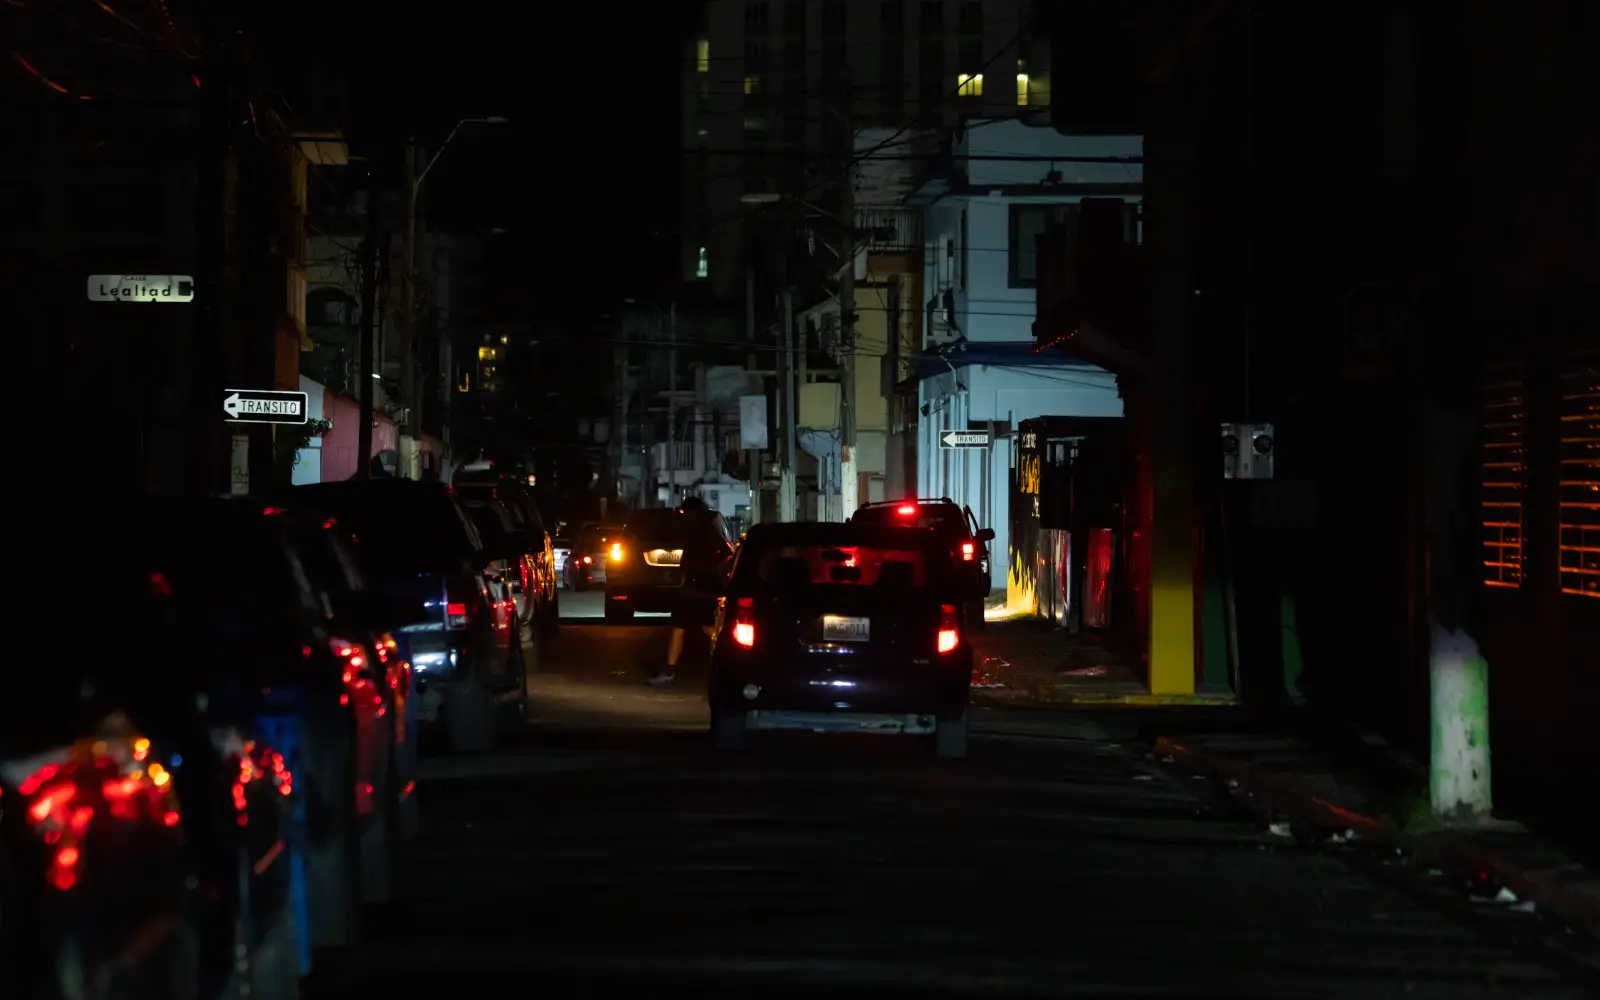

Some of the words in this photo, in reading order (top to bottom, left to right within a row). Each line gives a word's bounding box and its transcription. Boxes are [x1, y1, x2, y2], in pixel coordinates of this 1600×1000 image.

[100, 284, 171, 296] Lealtad
[241, 400, 297, 413] TRANSITO
[956, 434, 986, 443] TRANSITO
